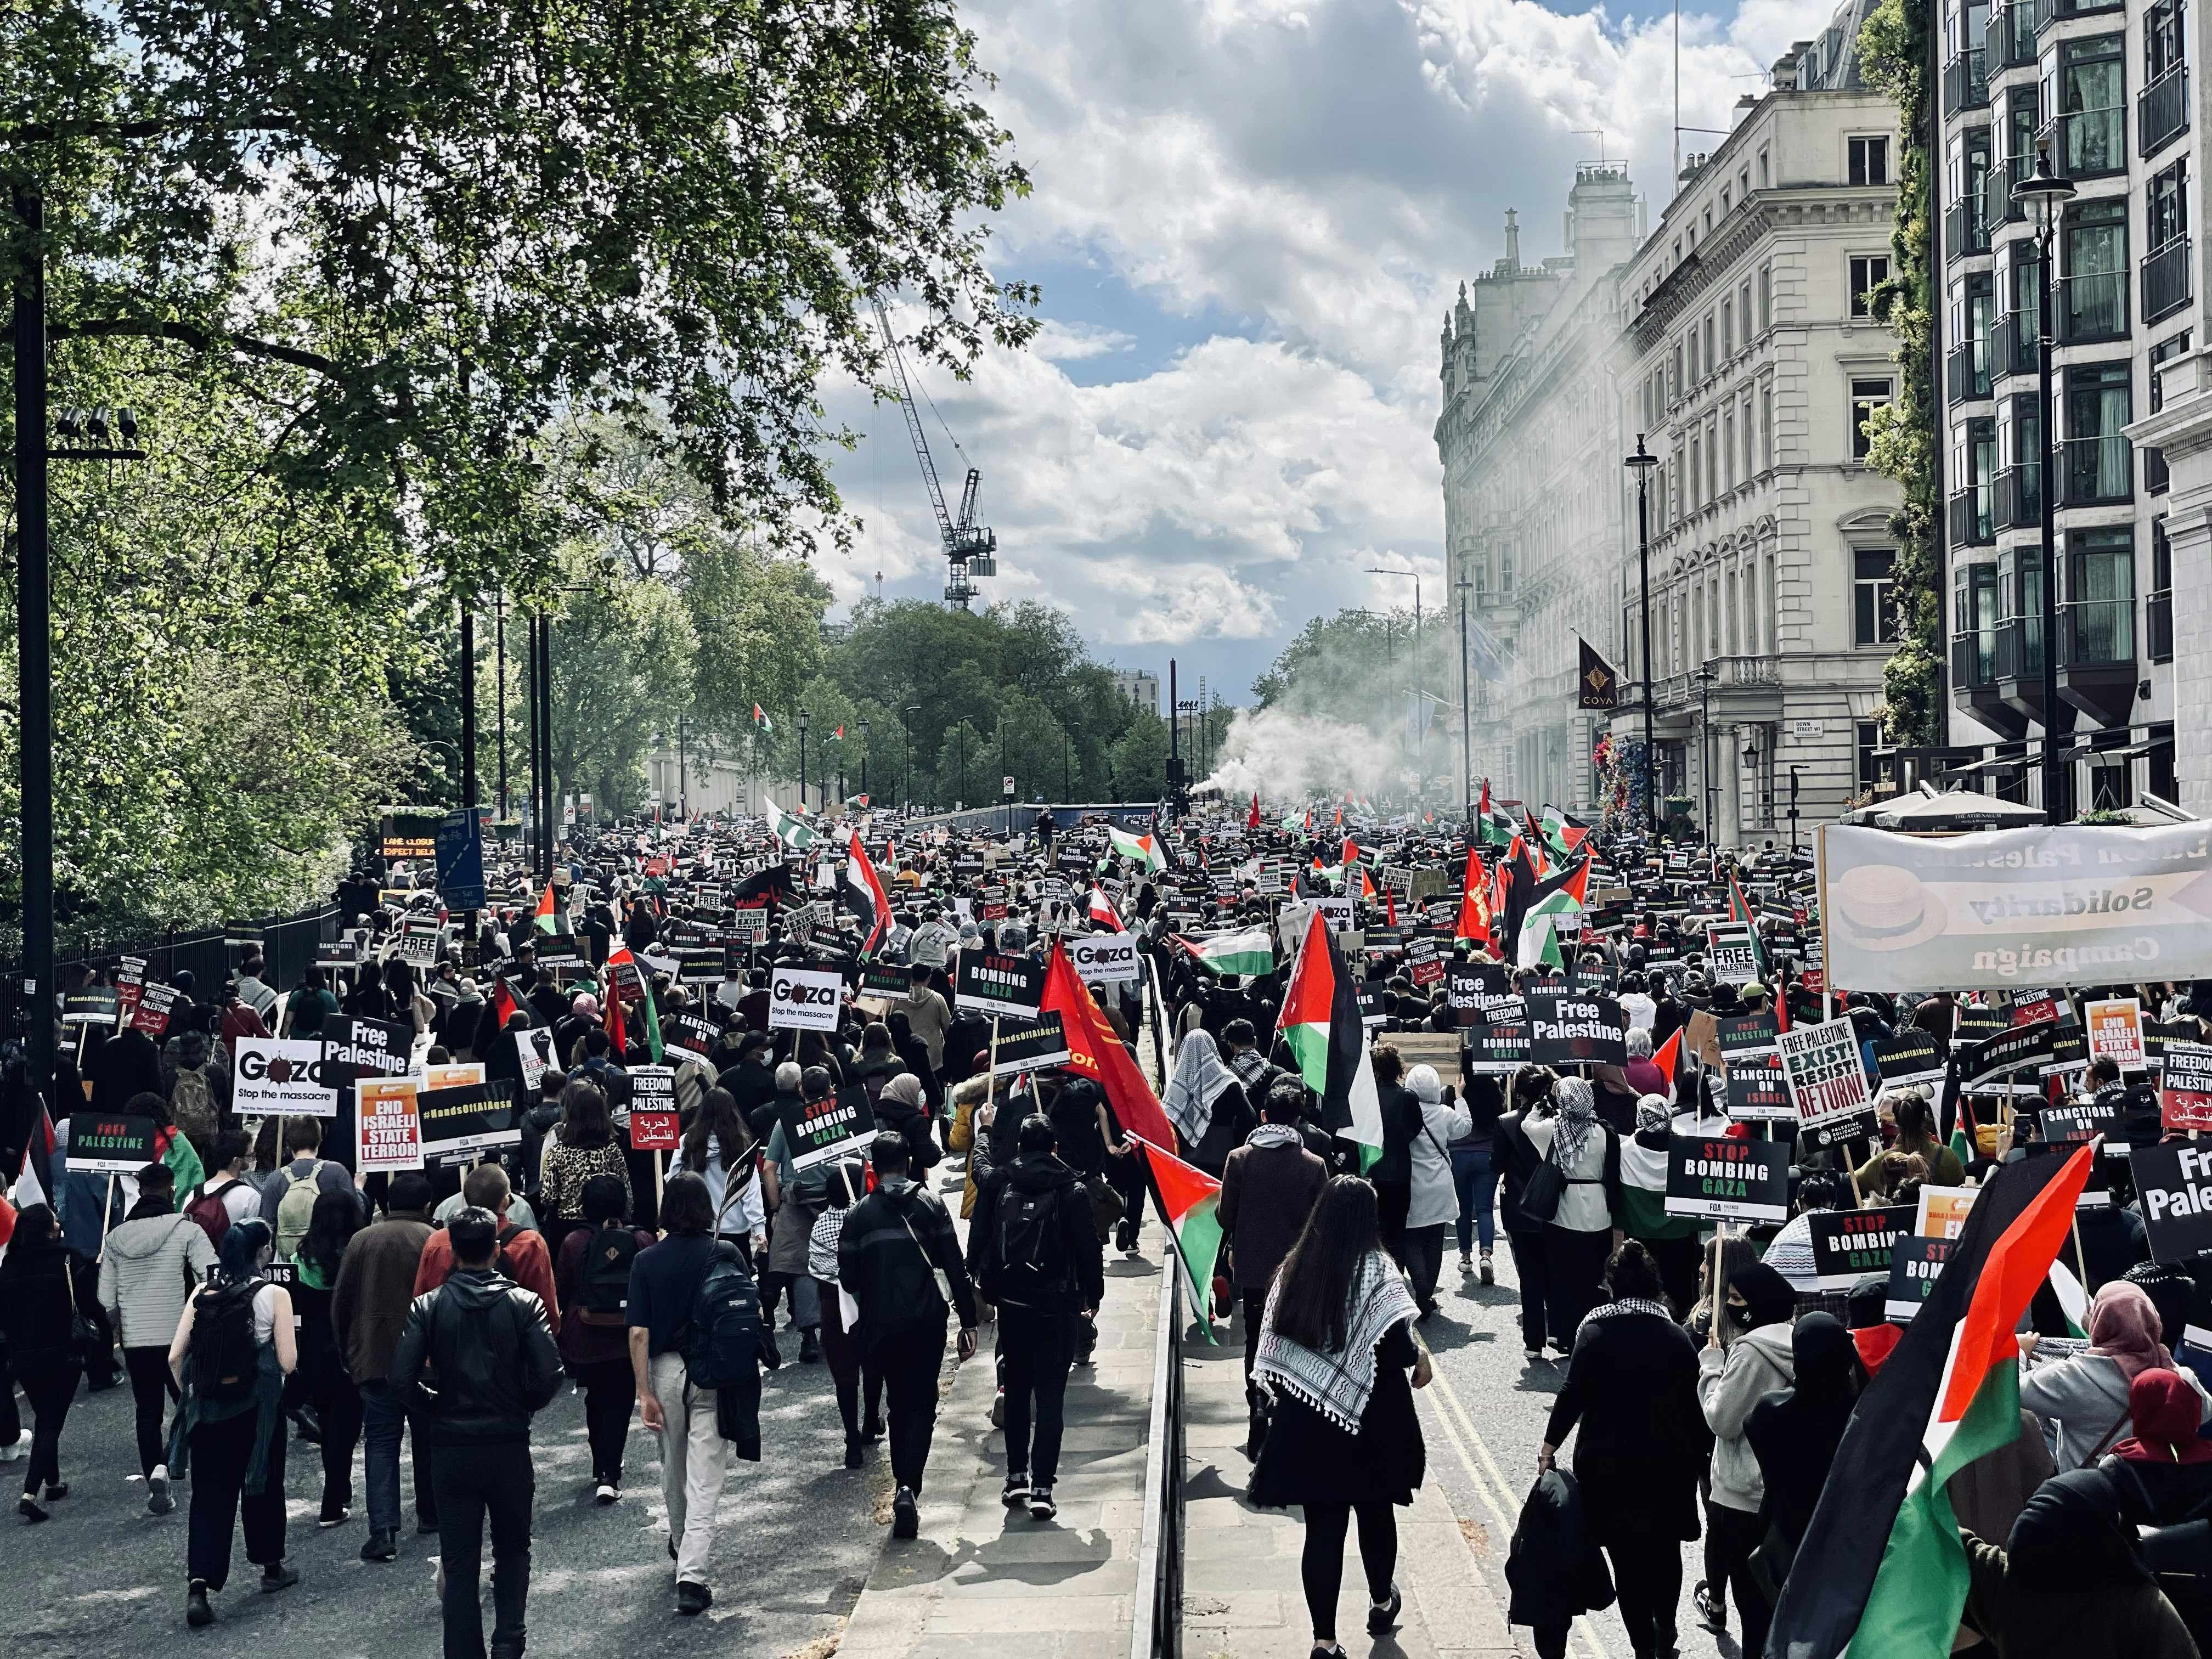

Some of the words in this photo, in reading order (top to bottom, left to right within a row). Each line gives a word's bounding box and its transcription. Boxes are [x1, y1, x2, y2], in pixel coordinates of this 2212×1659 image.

[1583, 696, 1613, 704] COYA
[1058, 853, 1088, 862] Palestine
[1065, 847, 1081, 855] Free
[953, 860, 983, 868] Palestine
[699, 896, 719, 905] FREE
[1430, 906, 1451, 917] FREEDOM
[789, 913, 817, 927] EXIST!
[1431, 915, 1454, 925] PALESTINE
[815, 930, 840, 941] BOMBING
[402, 937, 436, 951] FREE
[1410, 943, 1435, 956] FREEDOM
[1649, 947, 1675, 955] BOMBING
[400, 949, 434, 958] PALESTINE
[1412, 953, 1439, 966] PALESTINE
[1714, 948, 1754, 964] FREE
[121, 963, 143, 974] FREEDOM
[984, 956, 1015, 971] STOP
[1716, 962, 1755, 972] PALESTINE
[971, 966, 1028, 988] BOMBING
[1079, 967, 1092, 976] Stop
[1104, 966, 1135, 974] massacre
[117, 973, 143, 985] PALESTINE
[868, 977, 905, 986] PALESTINE
[1452, 974, 1485, 992] Free
[144, 989, 175, 1004] FREEDOM
[982, 981, 1013, 998] GAZA
[1531, 986, 1568, 995] BOMBING
[2014, 989, 2051, 1007] PALESTINE
[139, 999, 173, 1015] PALESTINE
[772, 1007, 785, 1015] Stop
[798, 1010, 833, 1019] massacre
[1555, 1000, 1600, 1020] Free
[2024, 1002, 2049, 1016] الحرية
[1486, 1008, 1523, 1022] FREEDOM
[680, 1014, 720, 1038] SANCTIONS
[1737, 1021, 1759, 1030] FREE
[2102, 1017, 2126, 1030] END
[351, 1020, 388, 1047] Free
[696, 1030, 707, 1042] ON
[1492, 1028, 1520, 1039] STOP
[1533, 1020, 1622, 1042] Palestine
[1725, 1029, 1774, 1042] PALESTINE
[2094, 1027, 2137, 1042] ISRAELI
[1482, 1037, 1531, 1049] BOMBING
[1781, 1033, 1805, 1056] FREE
[1805, 1022, 1850, 1048] PALESTINE
[2099, 1040, 2134, 1052] STATE
[1493, 1048, 1520, 1059] GAZA
[1877, 1047, 1934, 1063] #HandsOffAlAqsa
[1983, 1035, 2041, 1061] BOMBING
[2172, 1044, 2198, 1053] Socialist
[325, 1041, 407, 1074] Palestine
[1786, 1040, 1856, 1074] EXIST!
[2095, 1049, 2140, 1062] TRROR
[1792, 1059, 1859, 1088] RESIST!
[634, 1077, 673, 1091] FREEDOM
[1758, 1080, 1774, 1092] ON
[238, 1088, 258, 1100] Stop
[261, 1090, 278, 1099] the
[280, 1092, 331, 1101] massacre
[1747, 1092, 1787, 1104] ISRAEL
[1796, 1073, 1867, 1120] RETURN!
[375, 1100, 403, 1115] END
[422, 1099, 512, 1121] #HandsOffAlAqsa
[632, 1097, 676, 1111] PALESTINE
[804, 1097, 838, 1120] STOP
[2047, 1106, 2116, 1122] SANCTIONS
[362, 1114, 416, 1130] ISRAELI
[640, 1116, 670, 1130] الحرية
[795, 1105, 857, 1138] BOMBING
[1831, 1121, 1860, 1133] PALESTINE
[2076, 1118, 2094, 1130] ON
[96, 1123, 127, 1136] FREE
[369, 1128, 410, 1144] STATE
[637, 1130, 674, 1143] لفلسطين
[812, 1123, 847, 1145] GAZA
[1832, 1124, 1864, 1138] SOLIDARITY
[1833, 1130, 1861, 1142] CAMPAIGN
[78, 1135, 144, 1150] PALESTINE
[459, 1138, 469, 1147] FOA
[362, 1142, 417, 1159] TERROR
[824, 1147, 833, 1155] FOA
[1703, 1142, 1750, 1162] STOP
[1684, 1159, 1769, 1182] BOMBING
[1702, 1178, 1747, 1197] GAZA
[1709, 1203, 1722, 1212] FOA
[1843, 1215, 1887, 1233] STOP
[1849, 1249, 1893, 1269] GAZA
